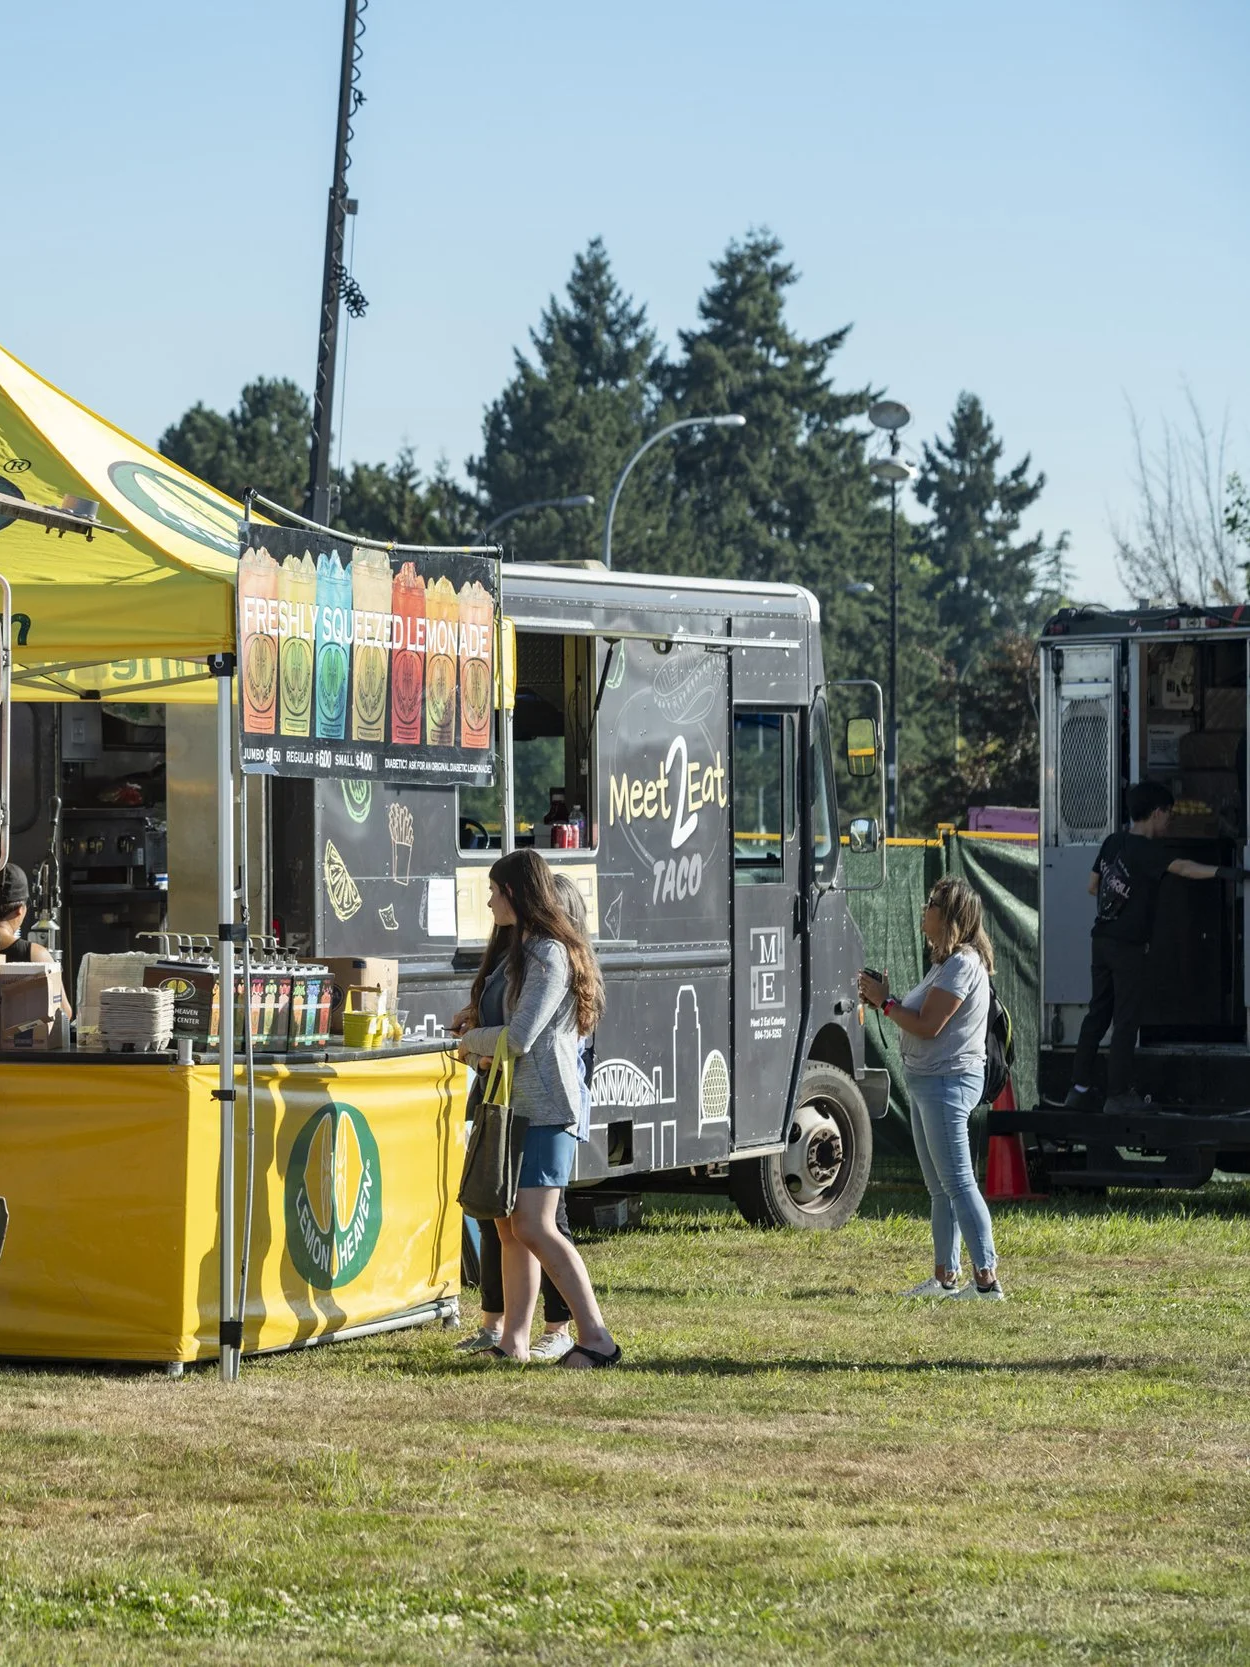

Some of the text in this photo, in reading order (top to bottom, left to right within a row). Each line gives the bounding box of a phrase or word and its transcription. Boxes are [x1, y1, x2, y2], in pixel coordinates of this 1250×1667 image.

[243, 597, 489, 658] FRESHLY SQUEEZED LEMONADE
[243, 748, 265, 761] JUMBO
[286, 751, 314, 764] REGULAR
[335, 754, 355, 766] SMALL
[408, 760, 417, 770] ASK
[417, 761, 426, 771] FOR
[450, 763, 467, 773] DIABETIC
[610, 735, 727, 849] Meet 2 Eat
[653, 853, 703, 905] TACO
[759, 934, 777, 963] M
[761, 972, 775, 1002] E
[174, 1007, 198, 1016] HEAVEN
[177, 1017, 200, 1025] CENTER
[296, 1187, 330, 1273] LEMON
